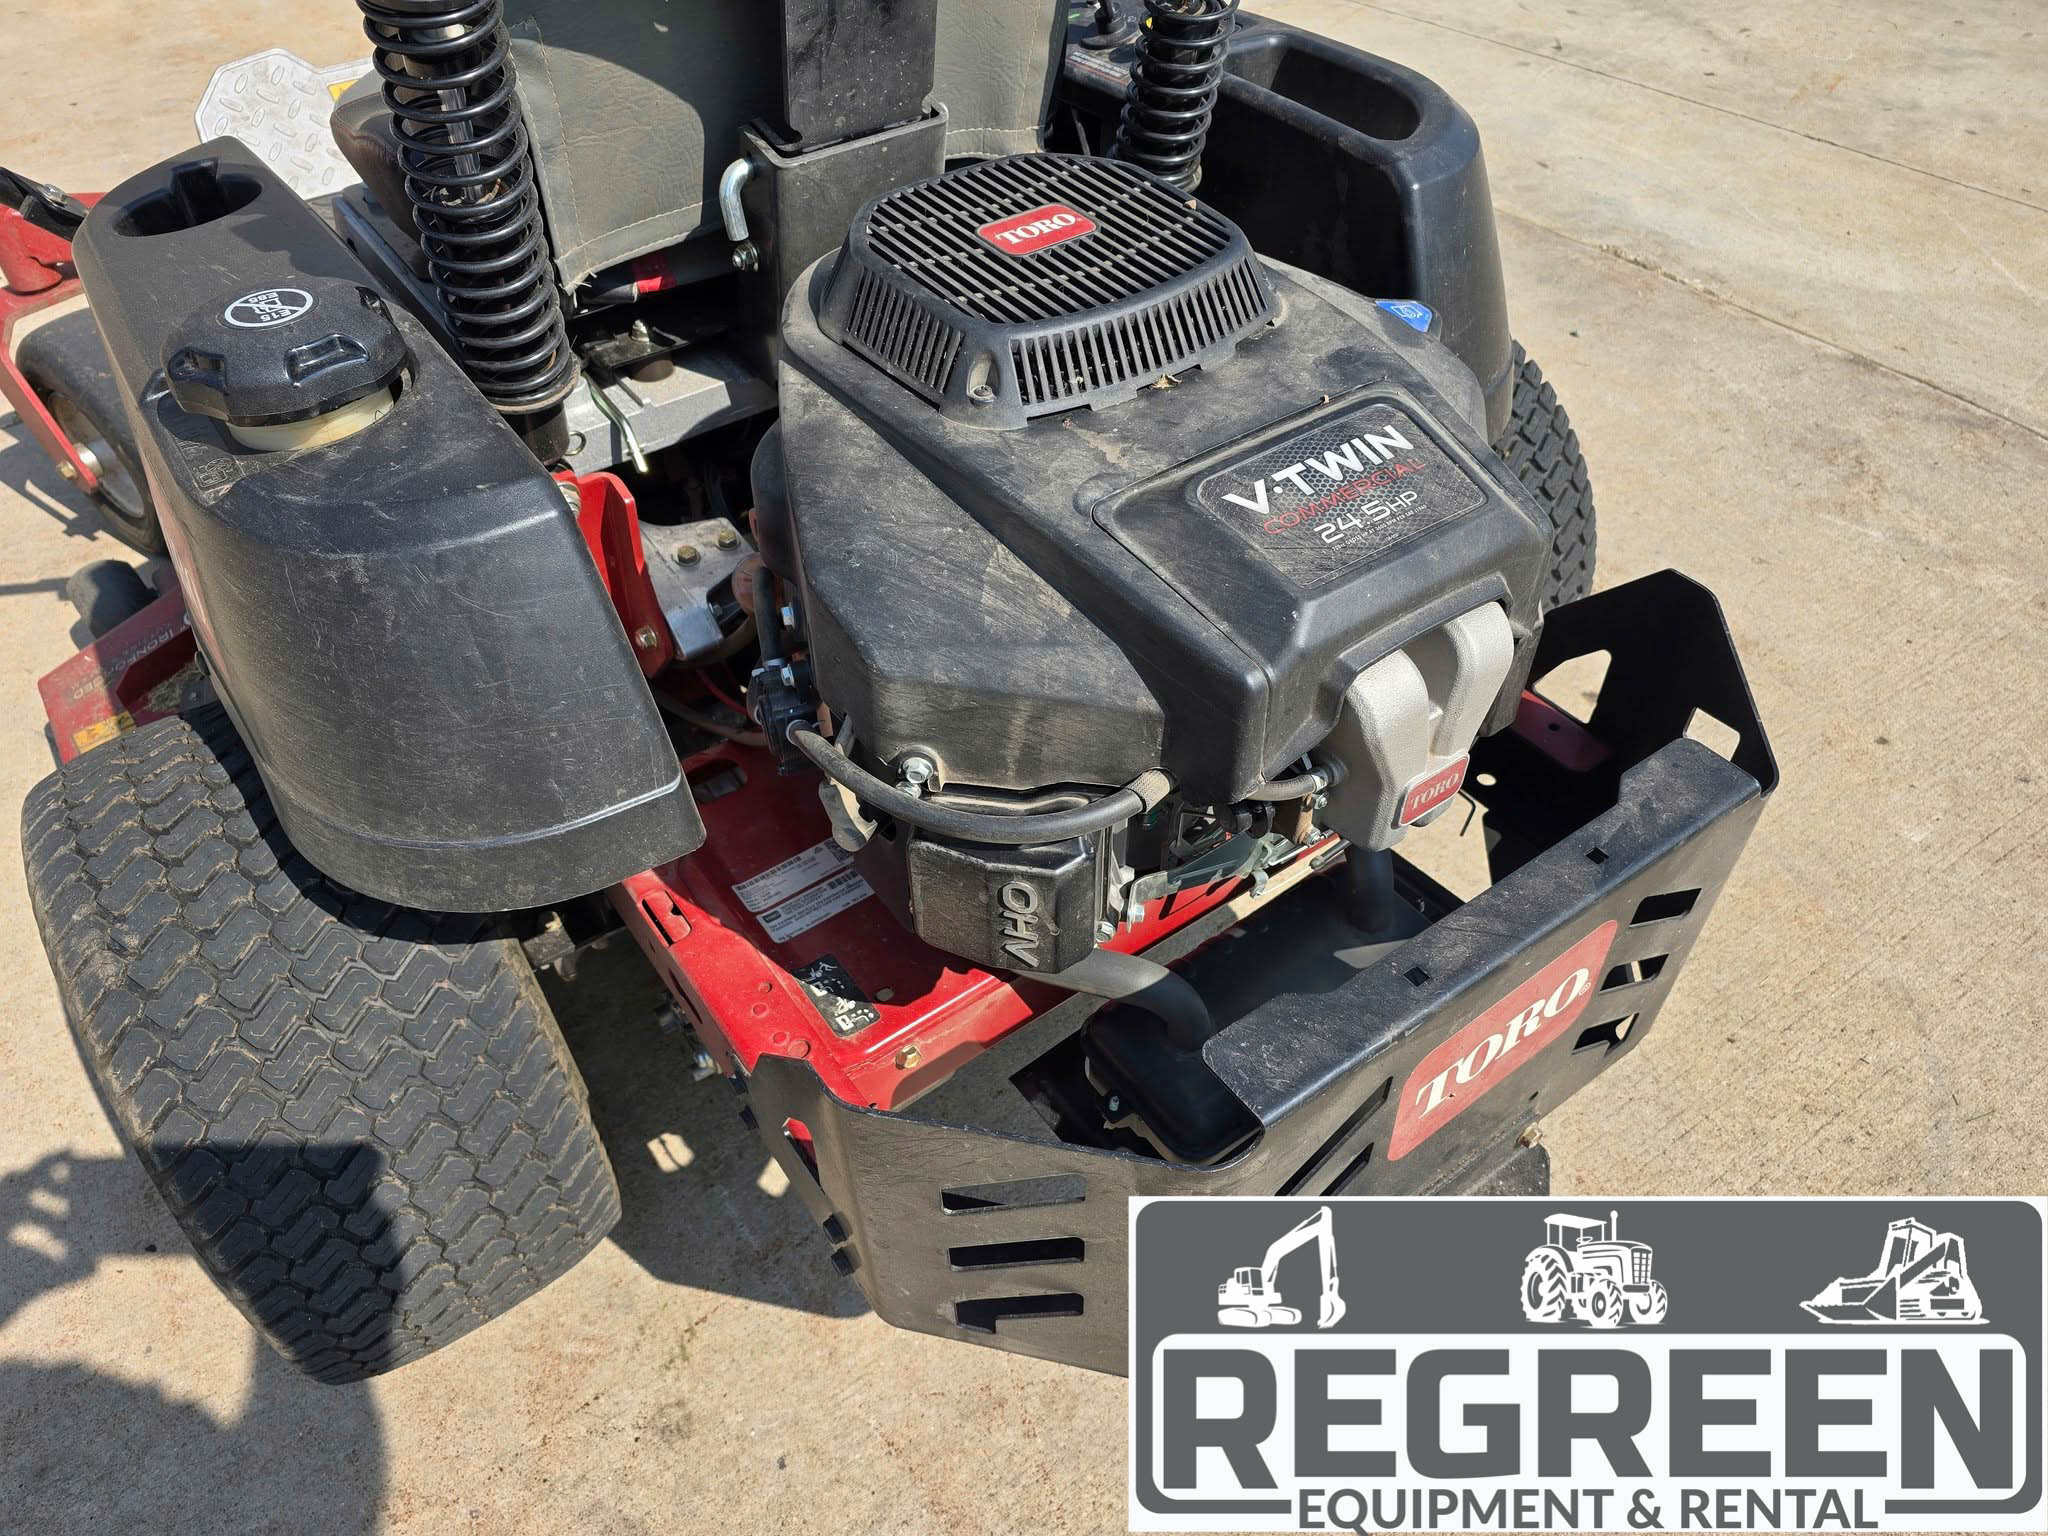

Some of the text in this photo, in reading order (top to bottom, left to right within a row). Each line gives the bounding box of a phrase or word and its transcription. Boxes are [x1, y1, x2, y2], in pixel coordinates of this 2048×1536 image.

[995, 213, 1077, 245] TORO
[260, 308, 292, 322] E15
[1263, 456, 1426, 535] COMMERCIAL
[73, 628, 175, 700] IRONFOGED
[1410, 772, 1460, 810] TORO
[1000, 881, 1040, 968] OHV
[1415, 967, 1590, 1120] TORO
